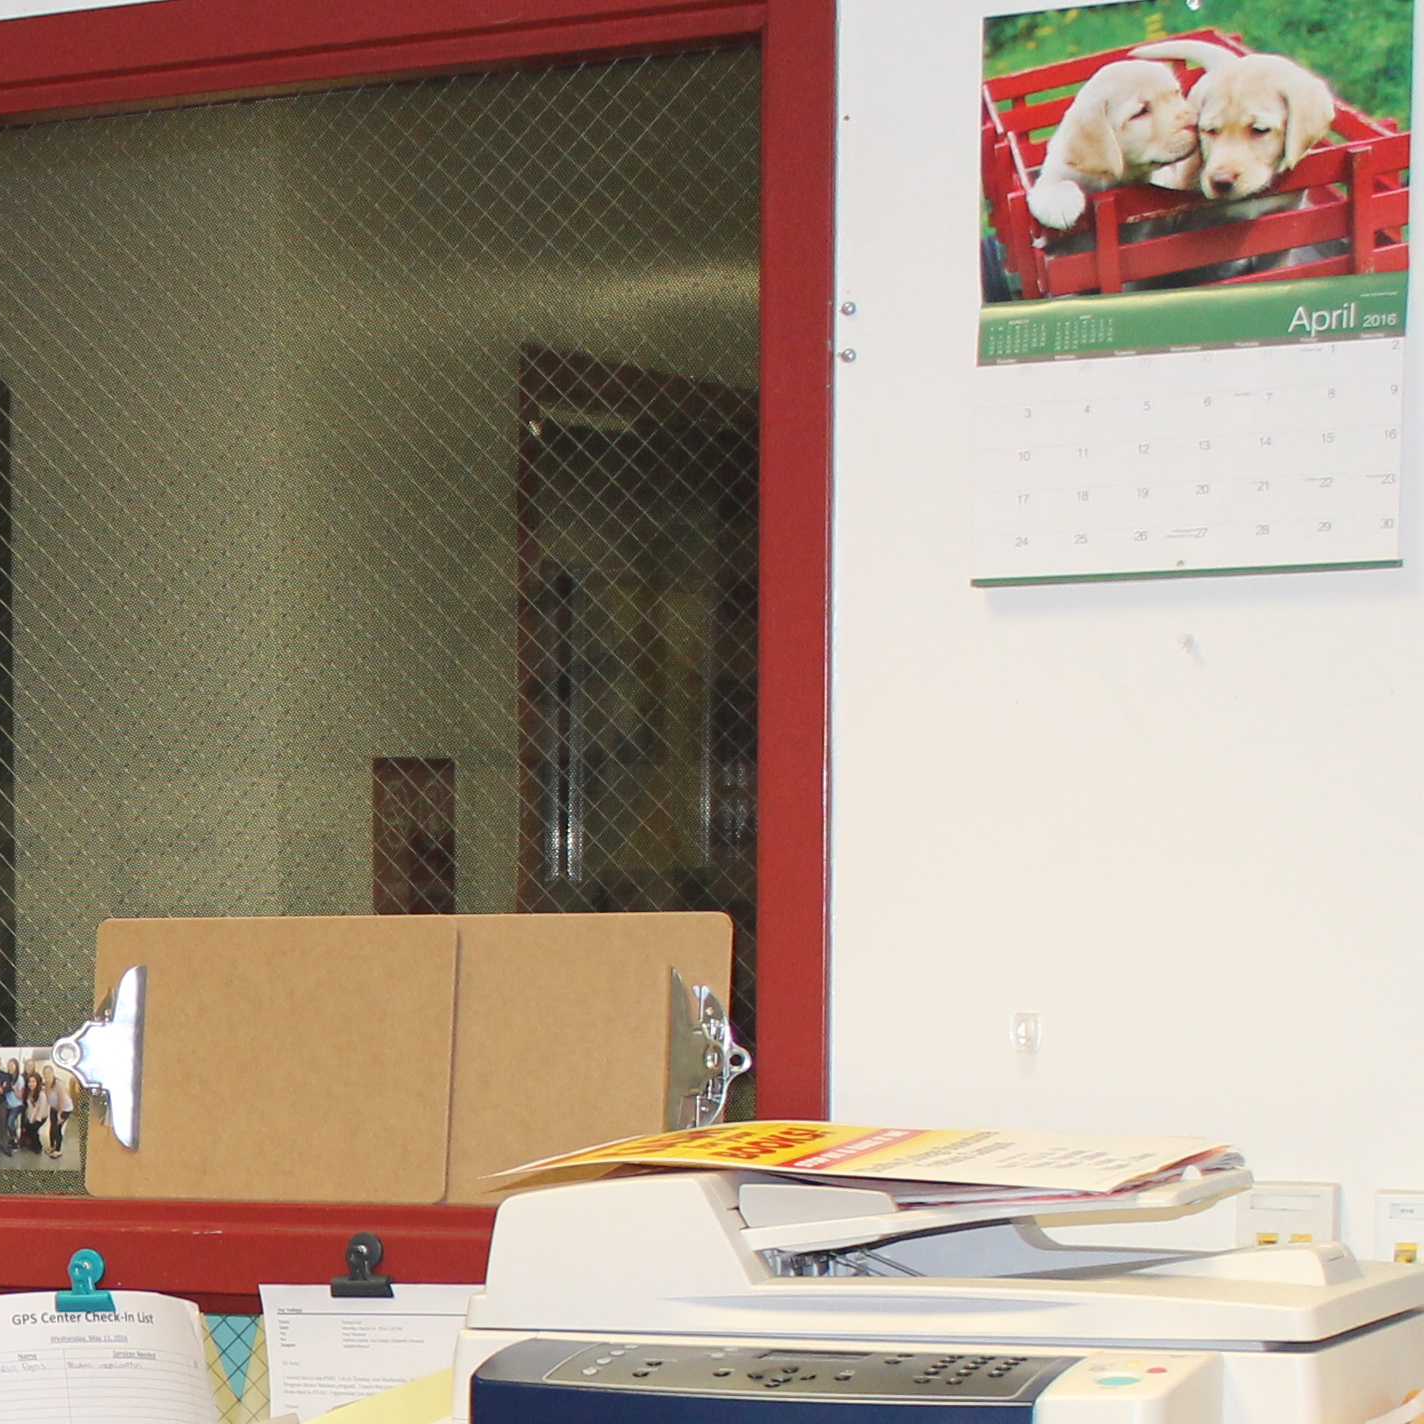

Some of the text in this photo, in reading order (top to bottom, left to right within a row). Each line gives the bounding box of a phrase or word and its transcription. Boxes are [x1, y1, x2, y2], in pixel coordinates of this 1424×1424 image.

[1288, 302, 1396, 337] April 2016
[1024, 384, 1397, 418] 3 4 5 6 7 8 9
[1019, 429, 1396, 460] 10 11 12 13 14 15 16
[1018, 474, 1395, 503] 17 18 19 20 21 22 23
[1016, 519, 1393, 547] 24 25 26 27 28 29 30
[12, 1311, 154, 1325] GPS Center Check-In List
